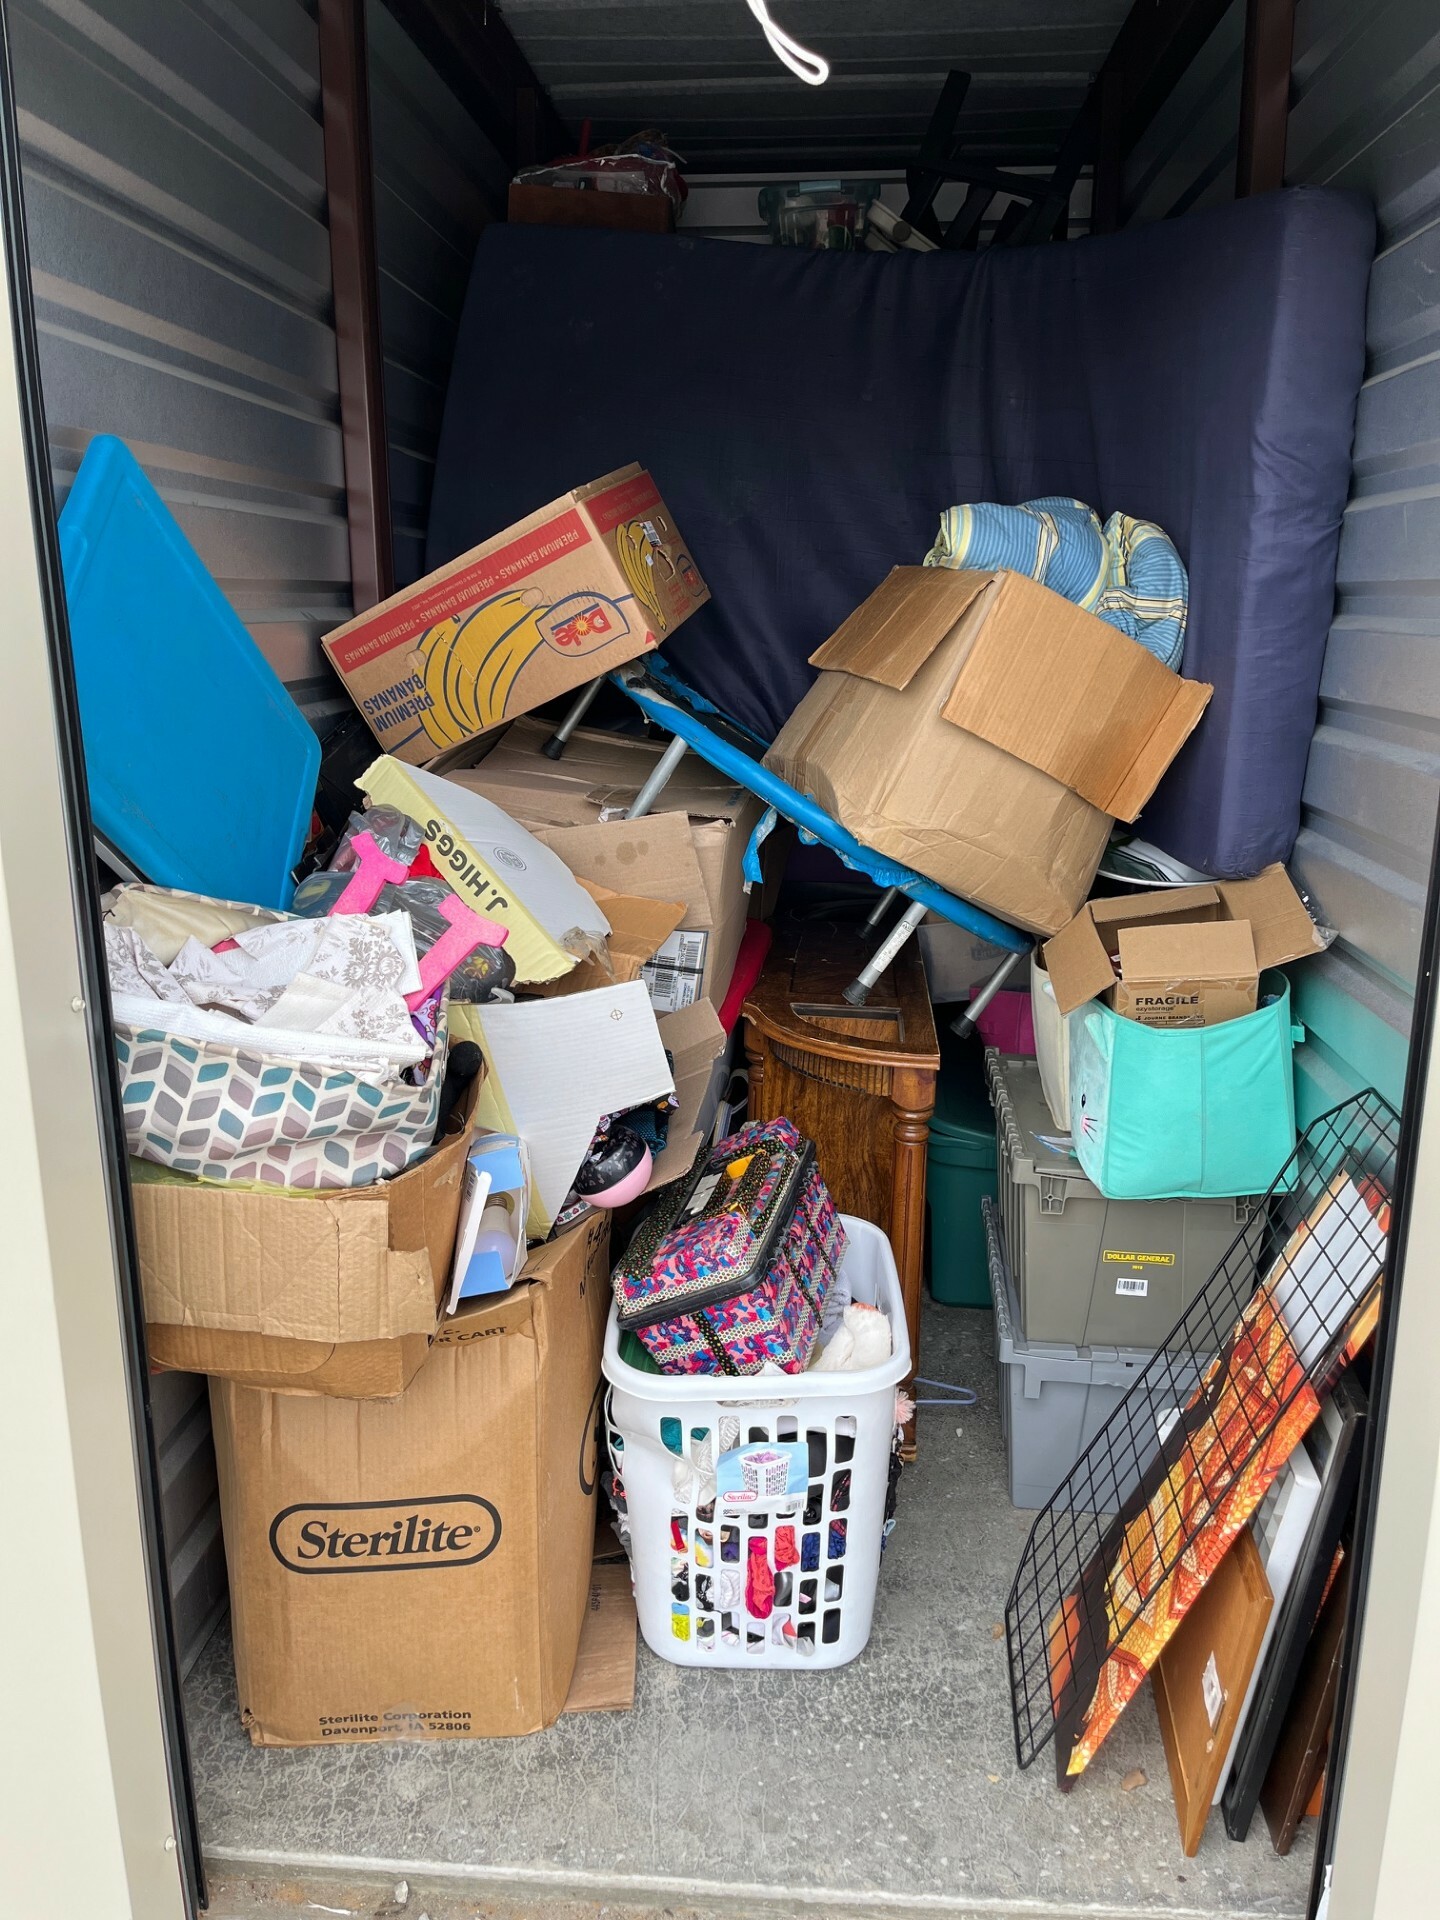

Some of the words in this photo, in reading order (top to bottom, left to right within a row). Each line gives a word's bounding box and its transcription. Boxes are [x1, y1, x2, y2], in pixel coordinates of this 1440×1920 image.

[539, 529, 580, 558] PREMIUM
[500, 552, 540, 579] BANANAS
[456, 576, 495, 602] PREMIUM
[420, 597, 458, 622] BANANAS
[379, 620, 416, 643] PREMIUM
[554, 607, 612, 647] Dole
[344, 640, 380, 664] BANANAS
[363, 674, 424, 715] BANANAS
[373, 691, 435, 732] PREMIUM
[424, 820, 490, 898] HIGGS
[1136, 996, 1199, 1006] FRAGILE
[1107, 1253, 1135, 1261] DOLLAR
[1137, 1254, 1170, 1263] GENERAL
[458, 1326, 507, 1341] CART
[298, 1514, 473, 1559] Sterilite
[319, 1714, 378, 1725] Sterilite
[384, 1710, 472, 1722] Corporation
[322, 1723, 402, 1736] Davenport,
[409, 1722, 424, 1731] IA
[428, 1722, 471, 1731] 52806
